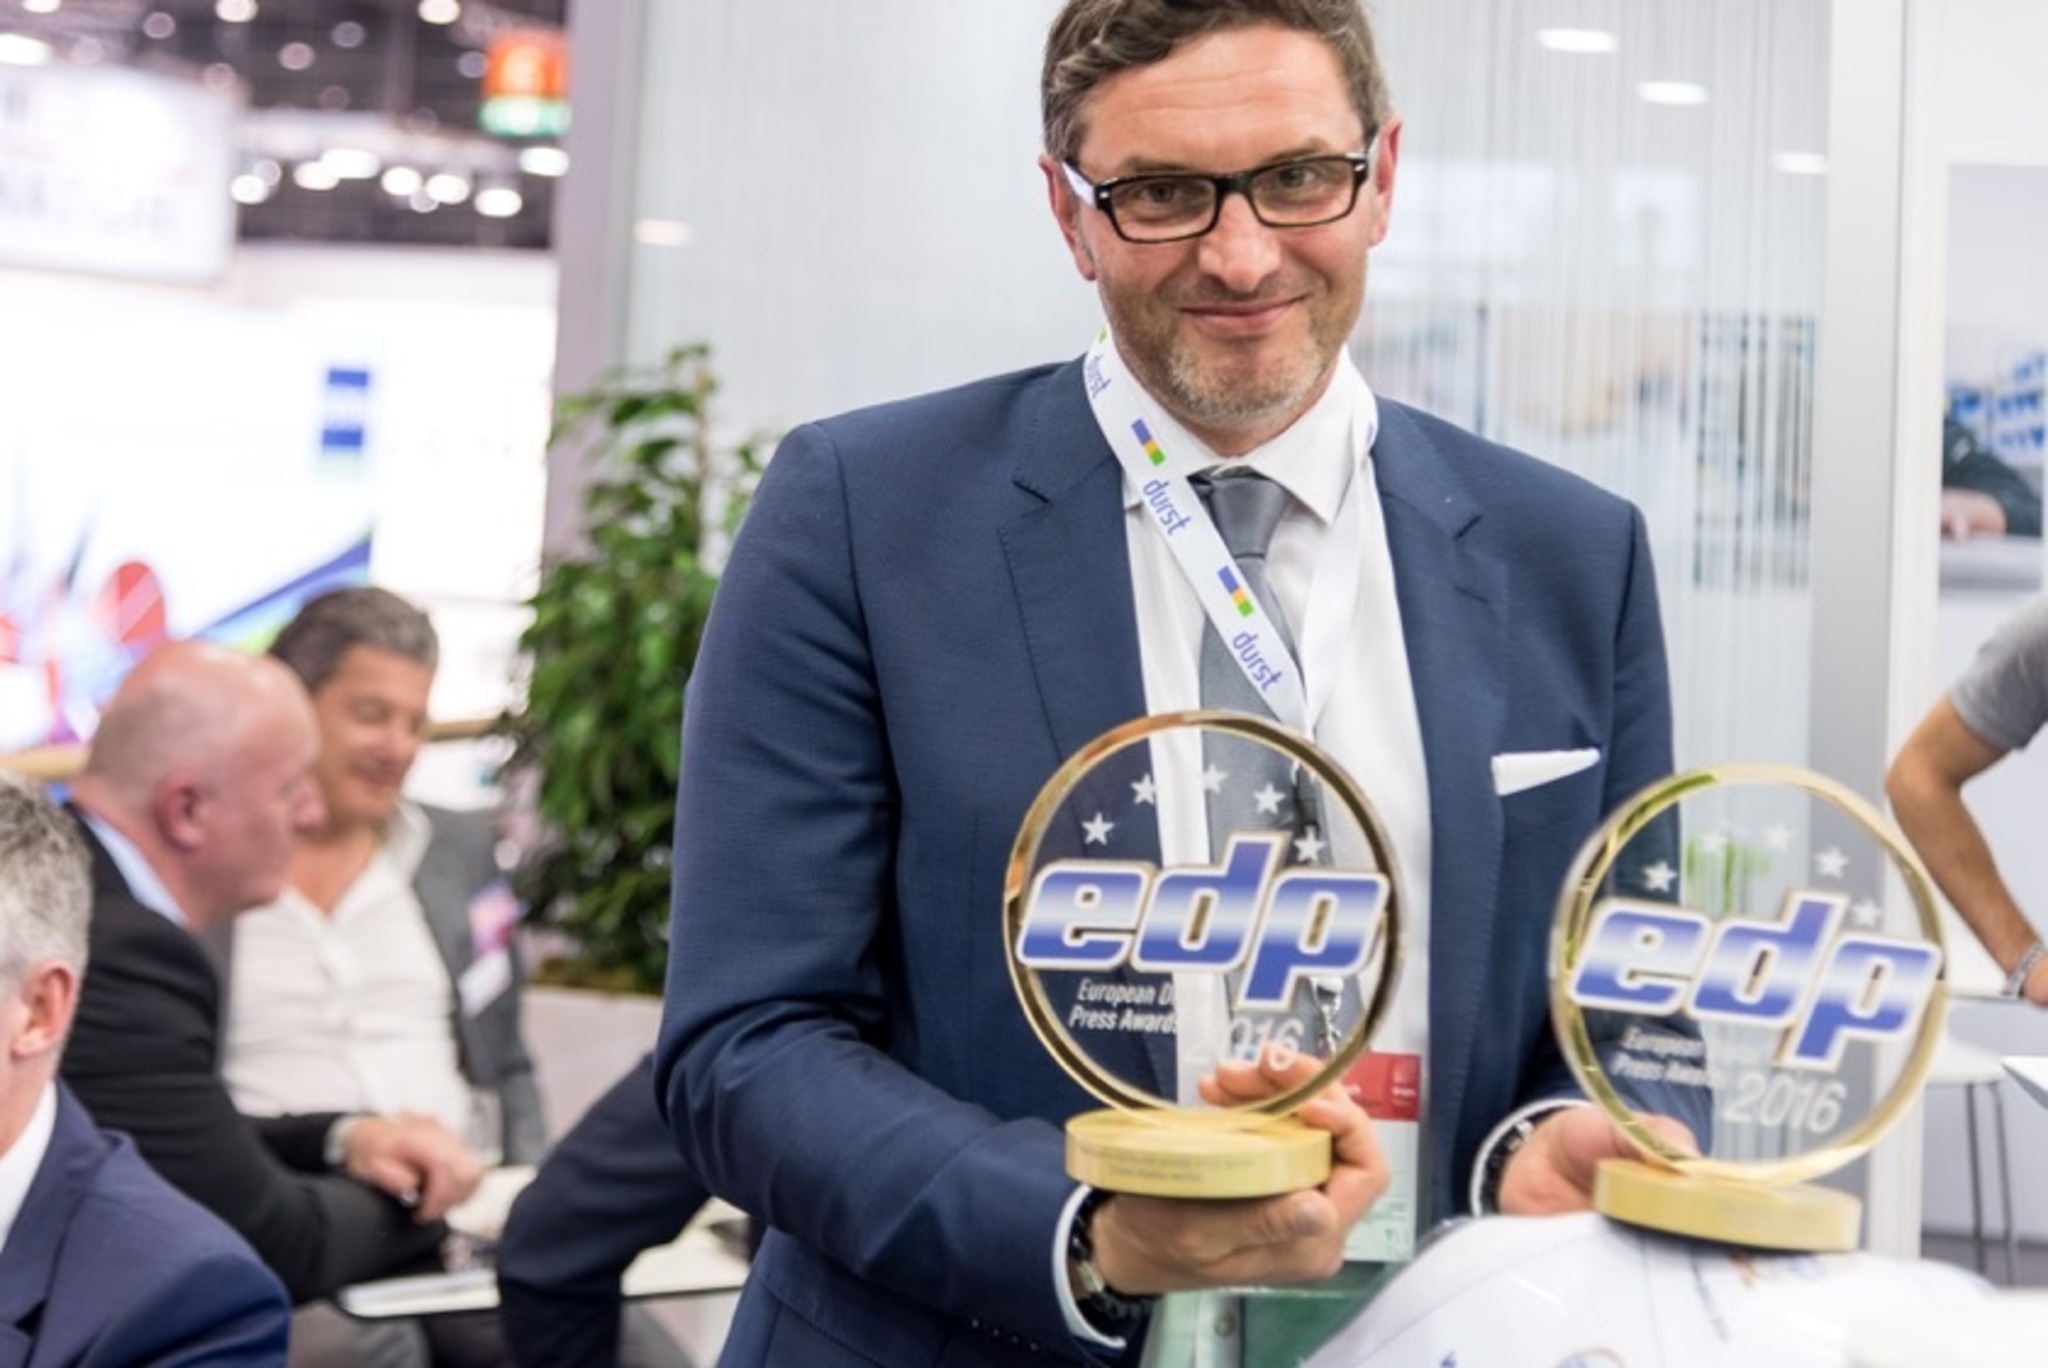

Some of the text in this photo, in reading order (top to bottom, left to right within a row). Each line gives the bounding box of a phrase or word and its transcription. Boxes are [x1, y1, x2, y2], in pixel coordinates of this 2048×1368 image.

[1142, 478, 1191, 535] durst
[1233, 631, 1283, 692] durst
[1015, 831, 1390, 1012] edp
[1077, 977, 1156, 1008] European
[1569, 888, 1944, 1072] edp
[1069, 1004, 1117, 1030] Press
[1722, 1068, 1848, 1134] 2016
